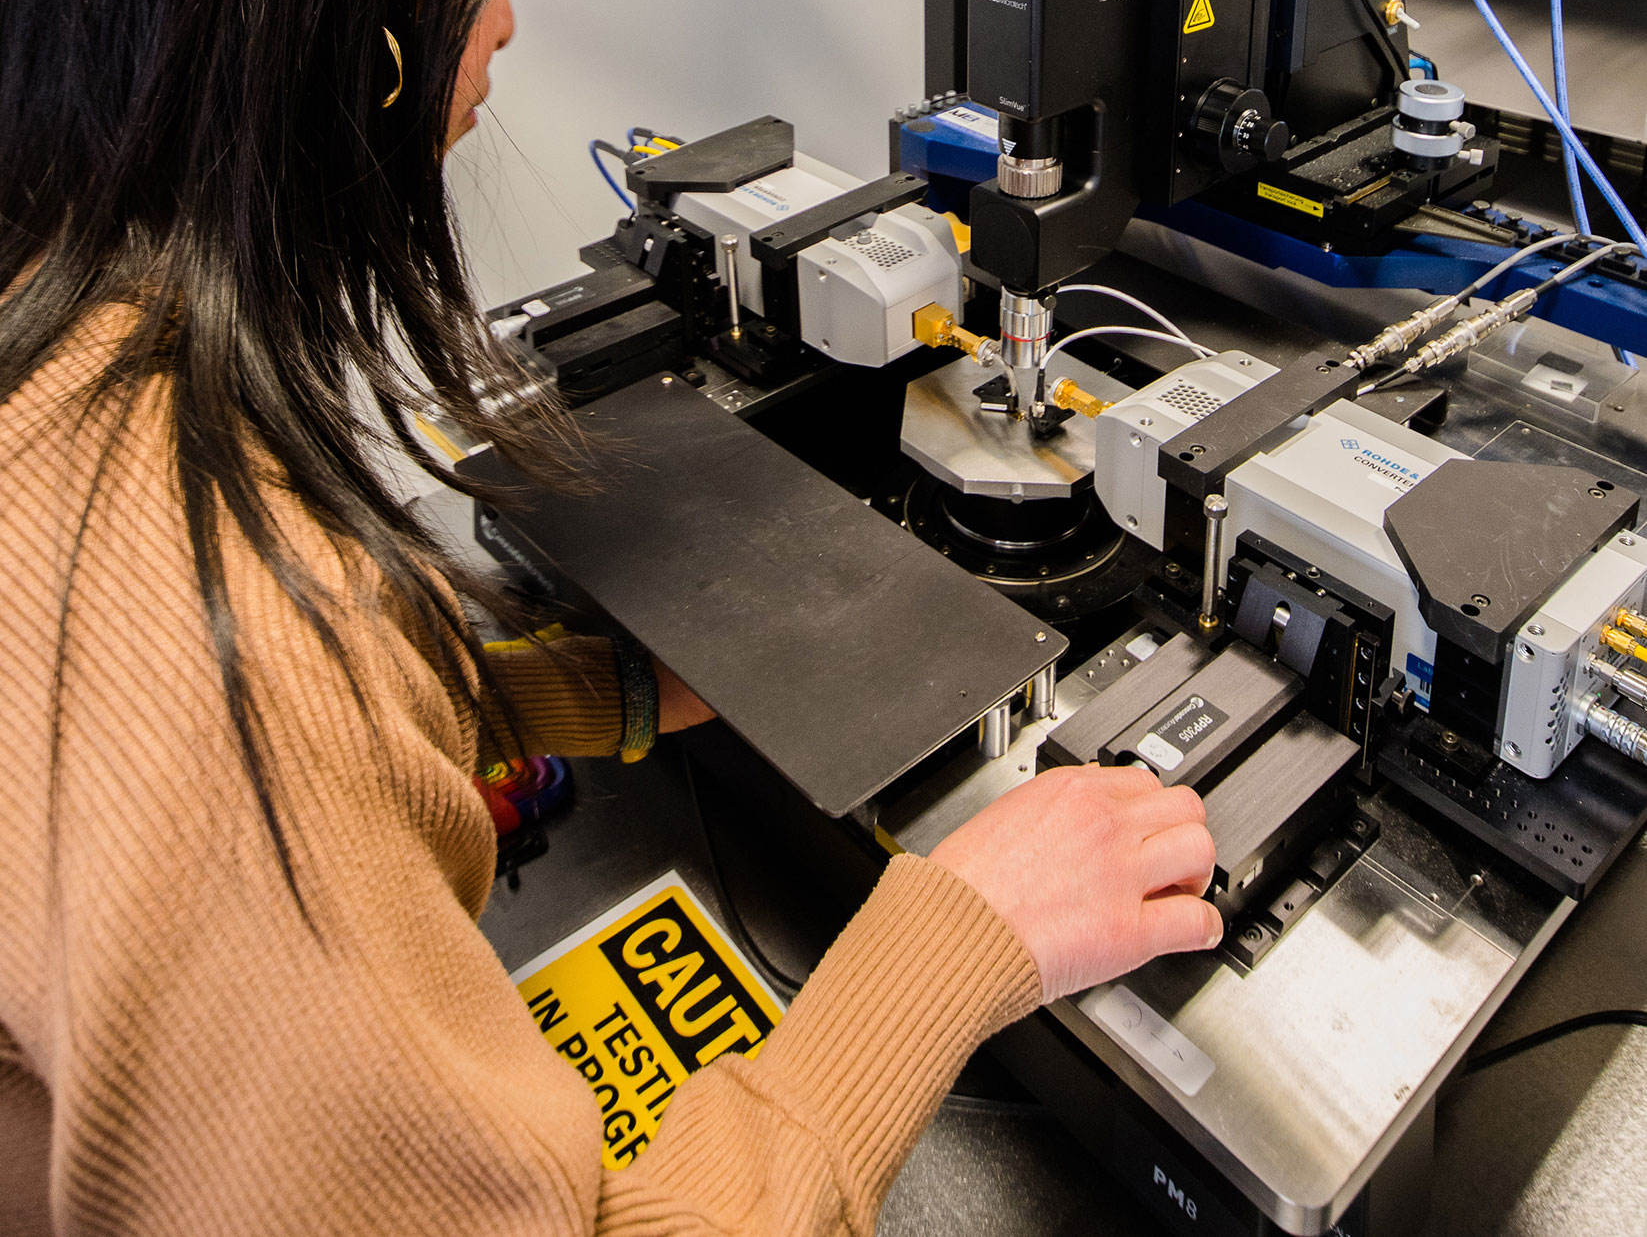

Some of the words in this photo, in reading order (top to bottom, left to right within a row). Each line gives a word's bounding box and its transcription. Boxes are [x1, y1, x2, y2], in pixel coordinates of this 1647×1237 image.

[1361, 449, 1411, 475] ROHDE
[1178, 713, 1214, 743] RPP305
[527, 988, 569, 1034] IN
[593, 1002, 676, 1122] TESTI
[1153, 1164, 1198, 1222] PM8
